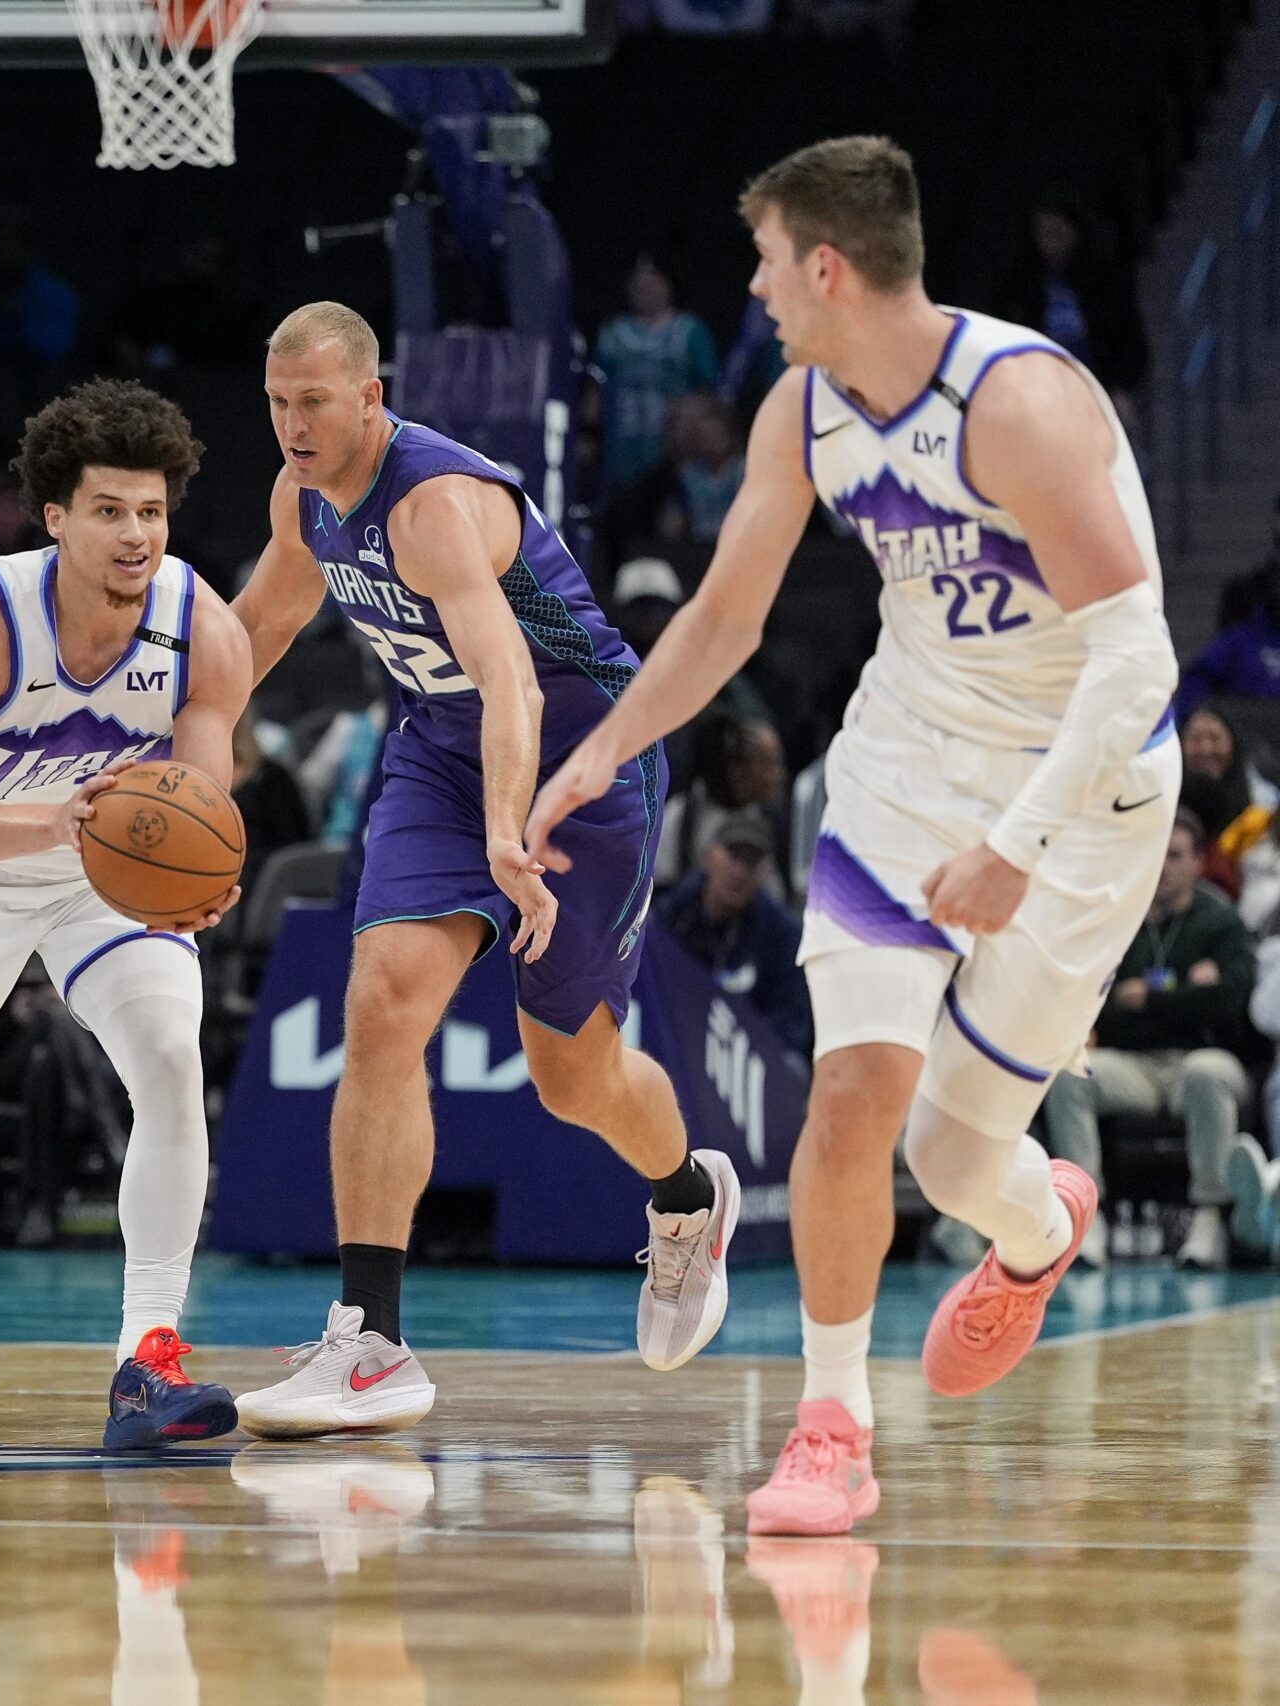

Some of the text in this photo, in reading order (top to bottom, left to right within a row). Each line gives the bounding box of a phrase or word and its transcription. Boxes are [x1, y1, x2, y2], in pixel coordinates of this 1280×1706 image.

[931, 571, 1032, 638] 22
[150, 632, 174, 649] FRANK
[126, 670, 169, 692] LVT
